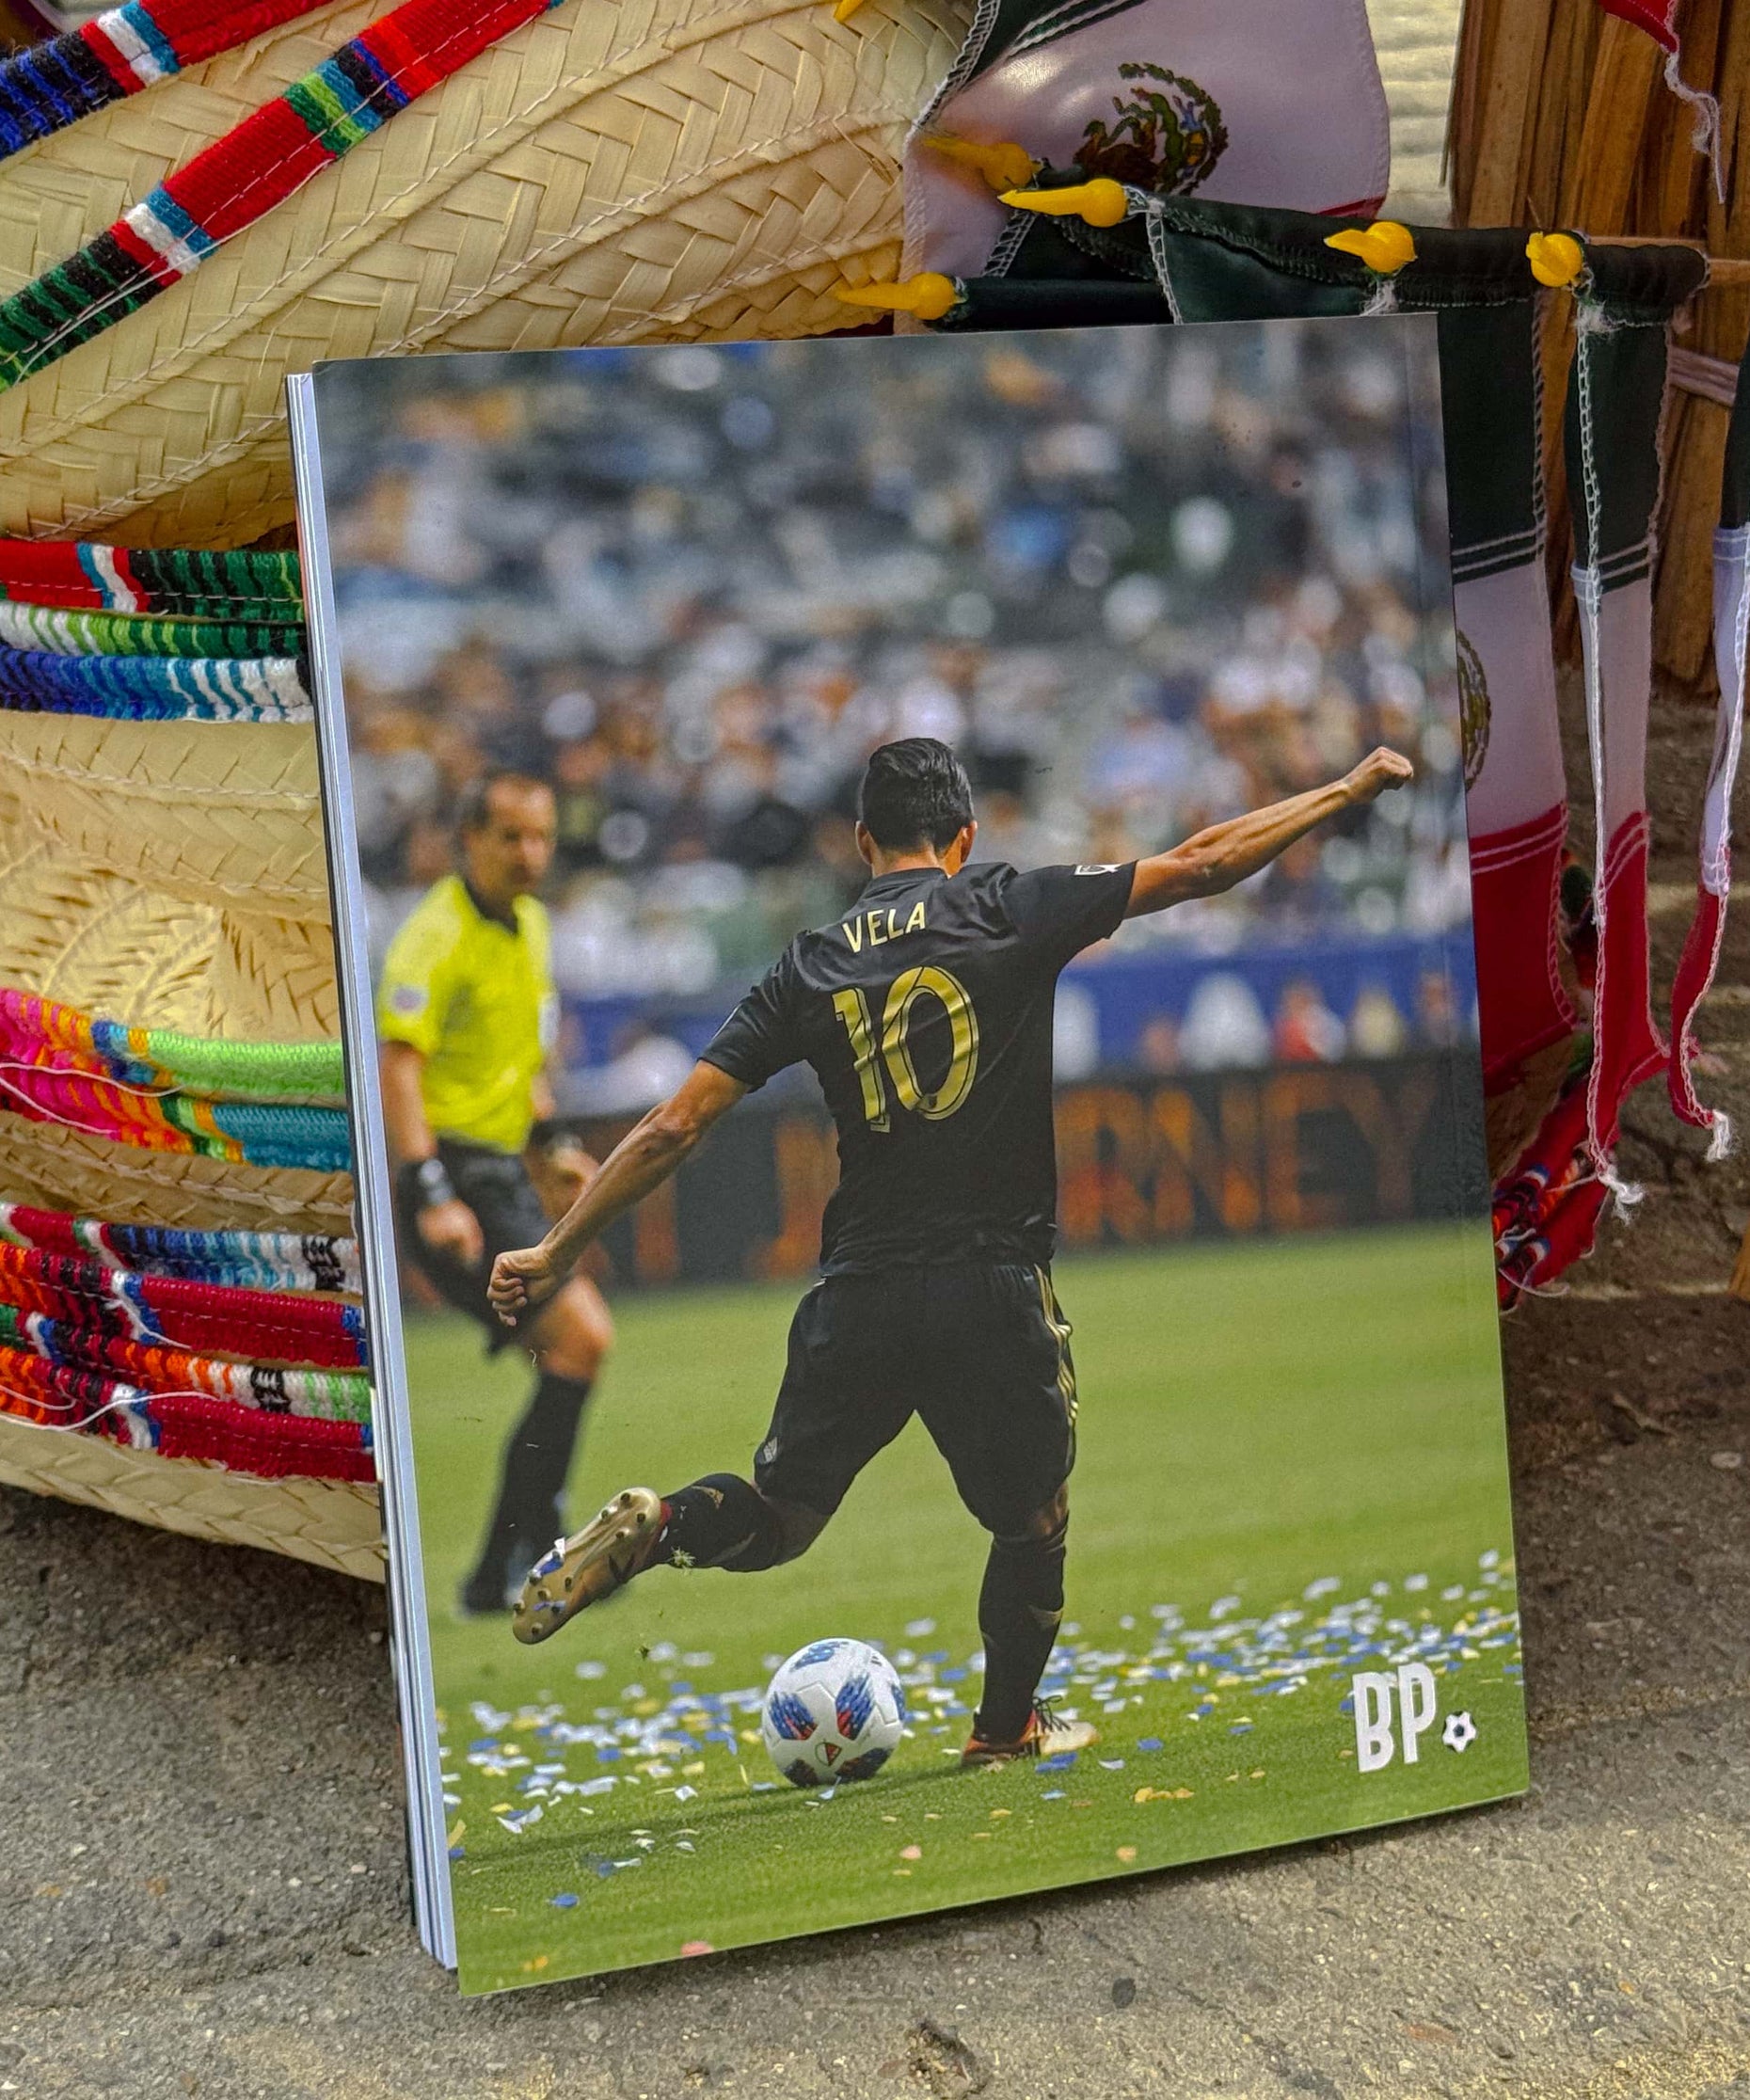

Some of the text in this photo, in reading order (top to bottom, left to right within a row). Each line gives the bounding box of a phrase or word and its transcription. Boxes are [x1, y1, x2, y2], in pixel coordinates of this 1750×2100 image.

[842, 901, 927, 953] VELA
[832, 965, 979, 1133] 10
[1352, 1662, 1437, 1773] BP
